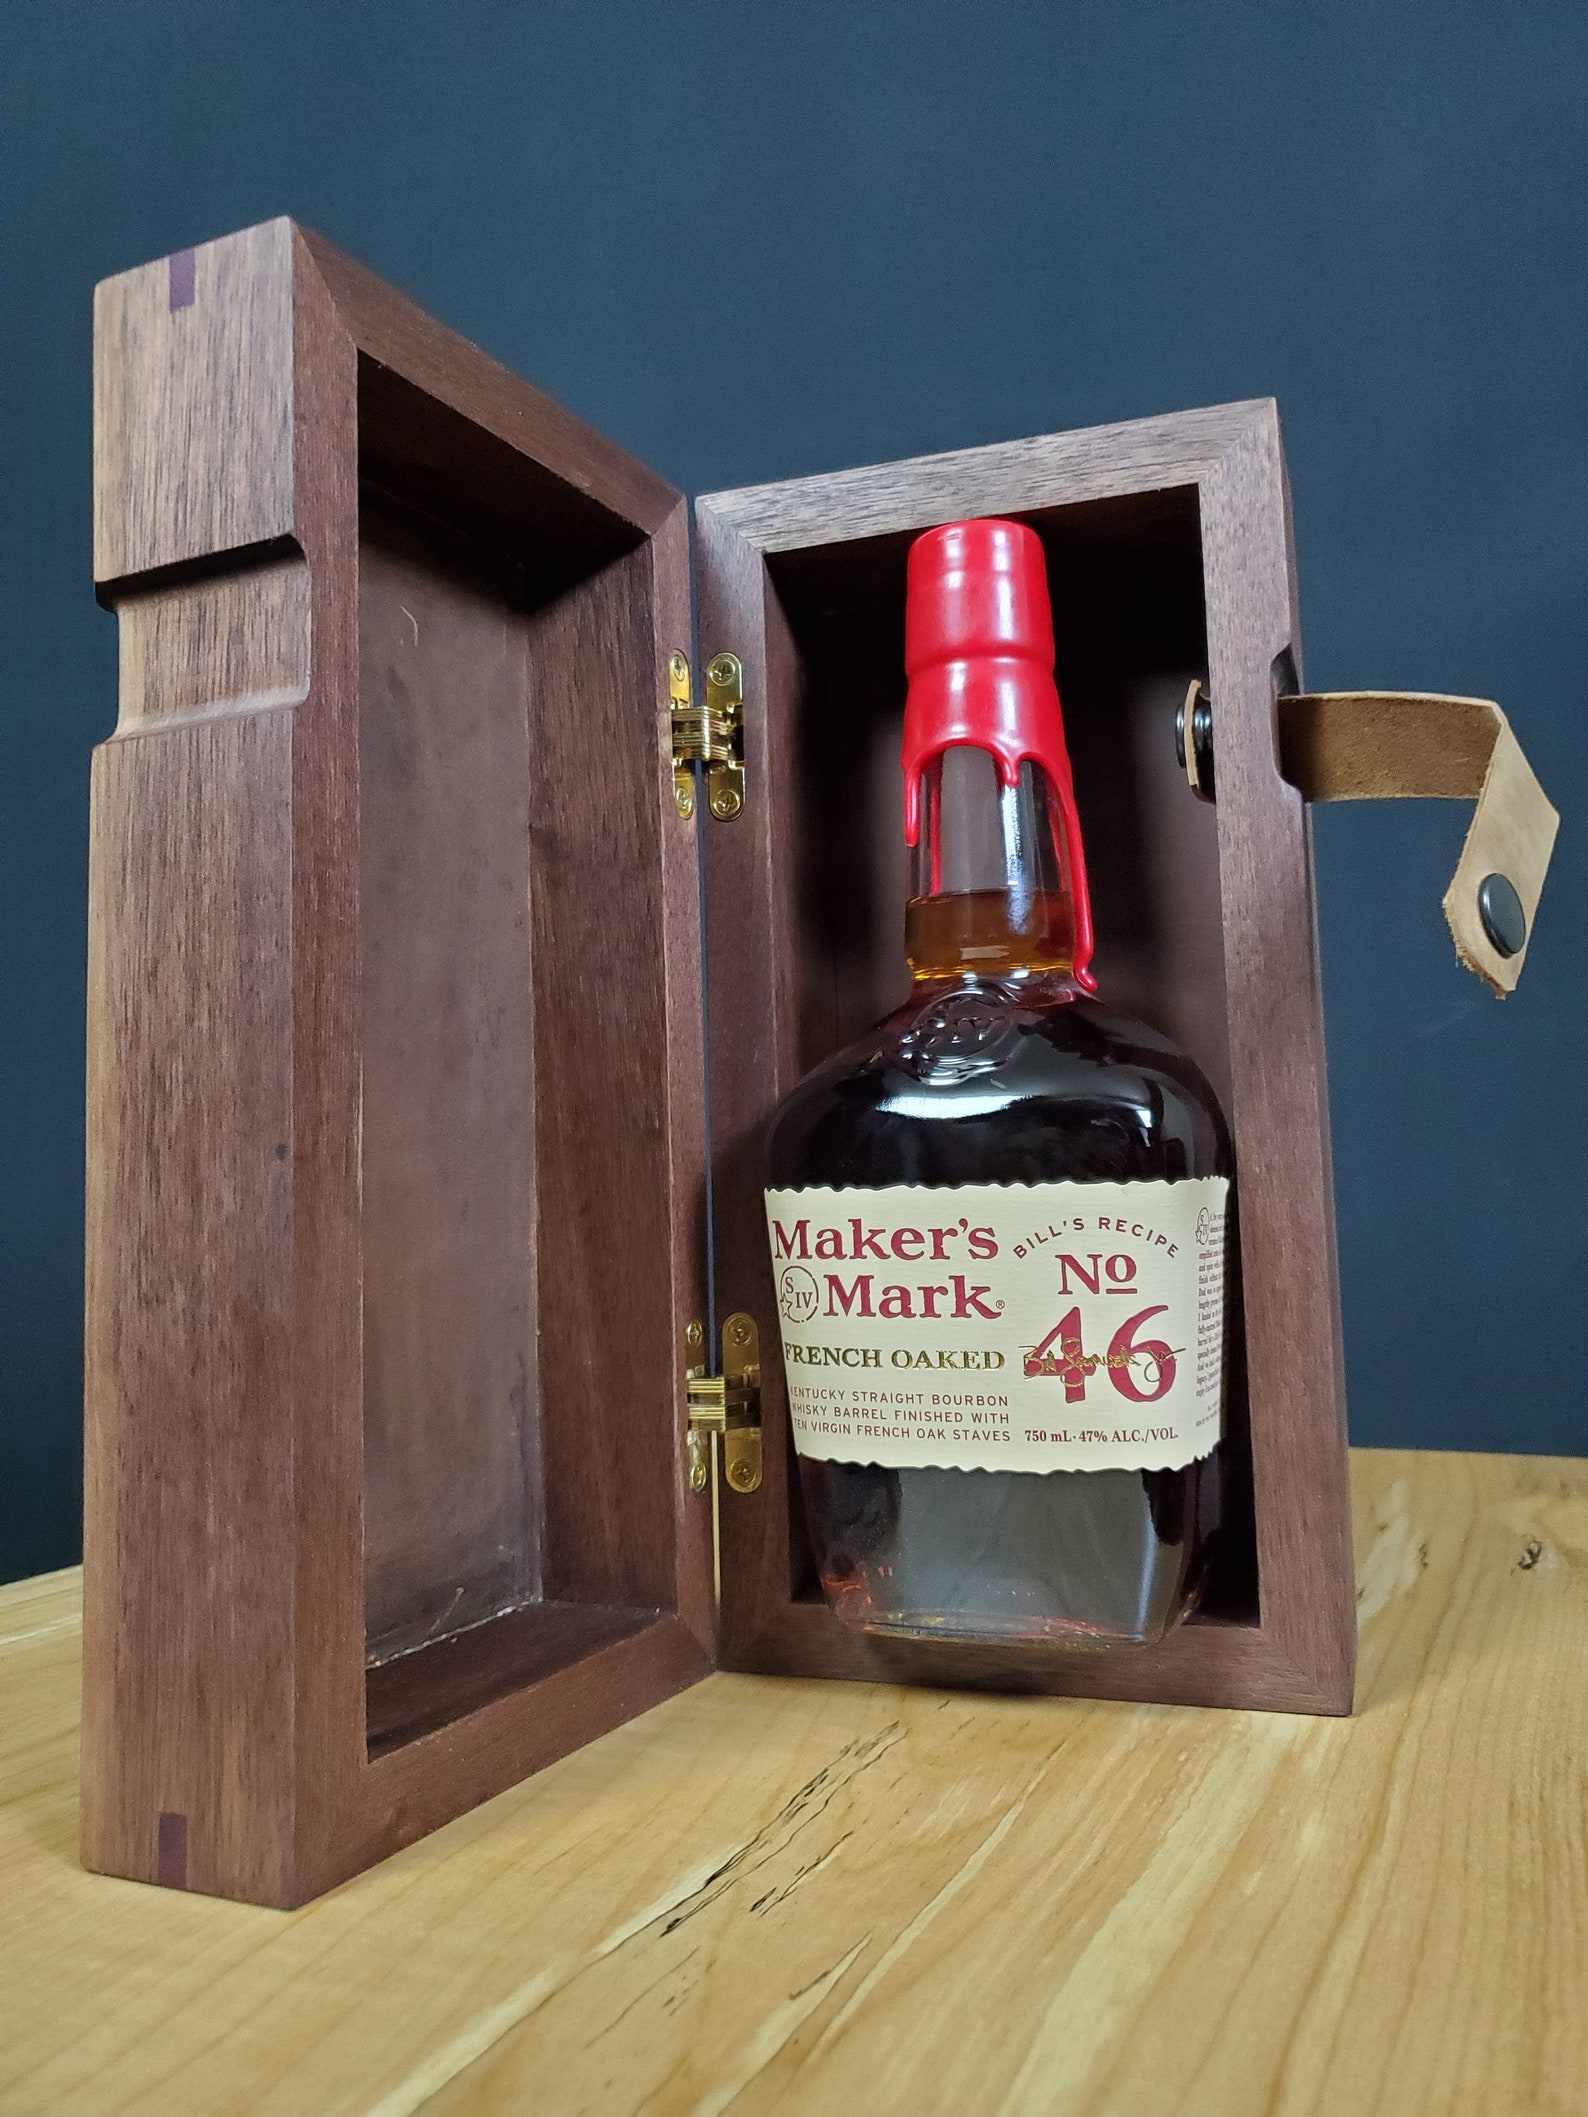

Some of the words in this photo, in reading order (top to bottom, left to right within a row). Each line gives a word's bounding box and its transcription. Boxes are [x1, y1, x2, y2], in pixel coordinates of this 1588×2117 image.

[772, 1218, 998, 1260] Maker's
[1013, 1218, 1084, 1259] BILL'S
[1098, 1217, 1179, 1258] RECIPE
[784, 1341, 883, 1368] FRENCH
[891, 1349, 1006, 1370] OAKED
[1024, 1305, 1176, 1403] 46
[852, 1391, 924, 1405] STRAIGHT
[932, 1394, 1009, 1407] BOURBON
[834, 1406, 887, 1420] BARREL
[894, 1410, 963, 1423] FINISHED
[971, 1412, 1010, 1424] WITH
[794, 1417, 808, 1430] TEN
[811, 1421, 851, 1434] VIRGIN
[857, 1425, 910, 1438] FRENCH
[916, 1428, 946, 1440] OAK
[953, 1429, 1010, 1442] STAVES
[1024, 1430, 1047, 1442] 750
